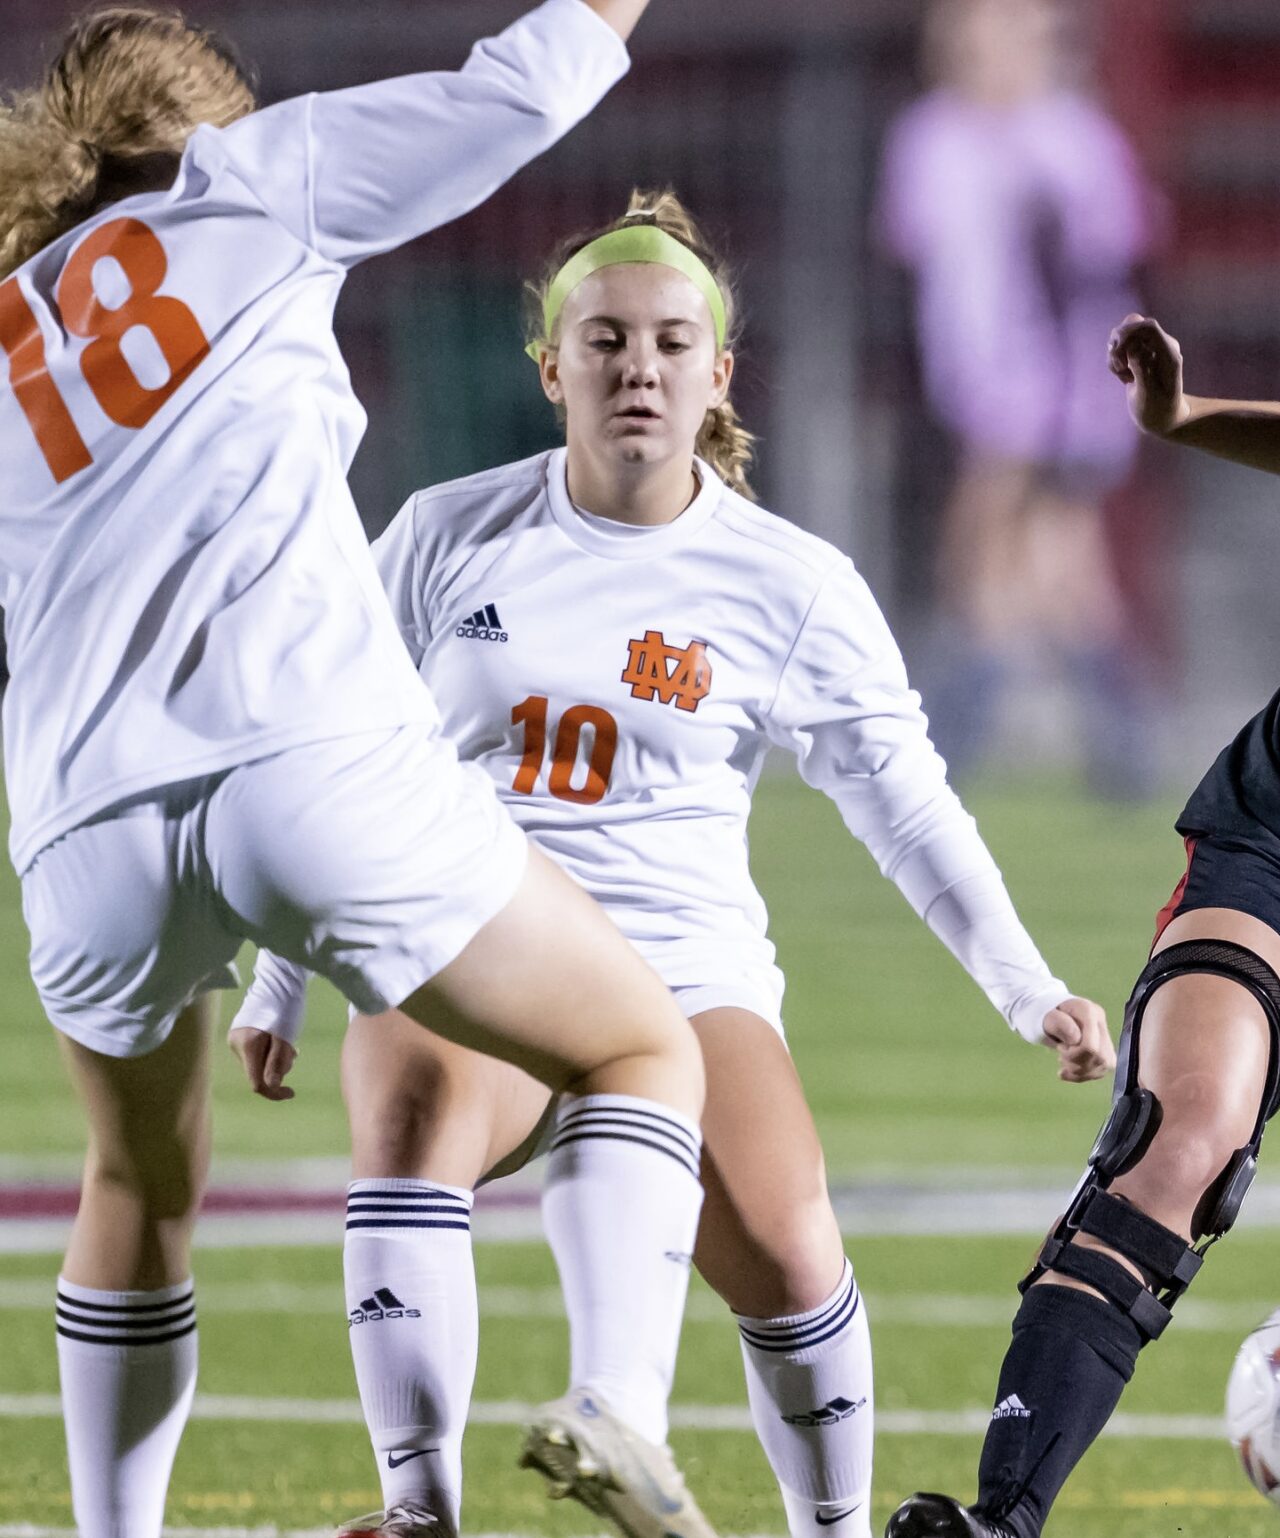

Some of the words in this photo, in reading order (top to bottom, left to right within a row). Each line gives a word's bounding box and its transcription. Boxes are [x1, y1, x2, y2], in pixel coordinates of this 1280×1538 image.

[0, 217, 212, 484] 18
[456, 625, 508, 643] adidas
[511, 695, 618, 805] 10
